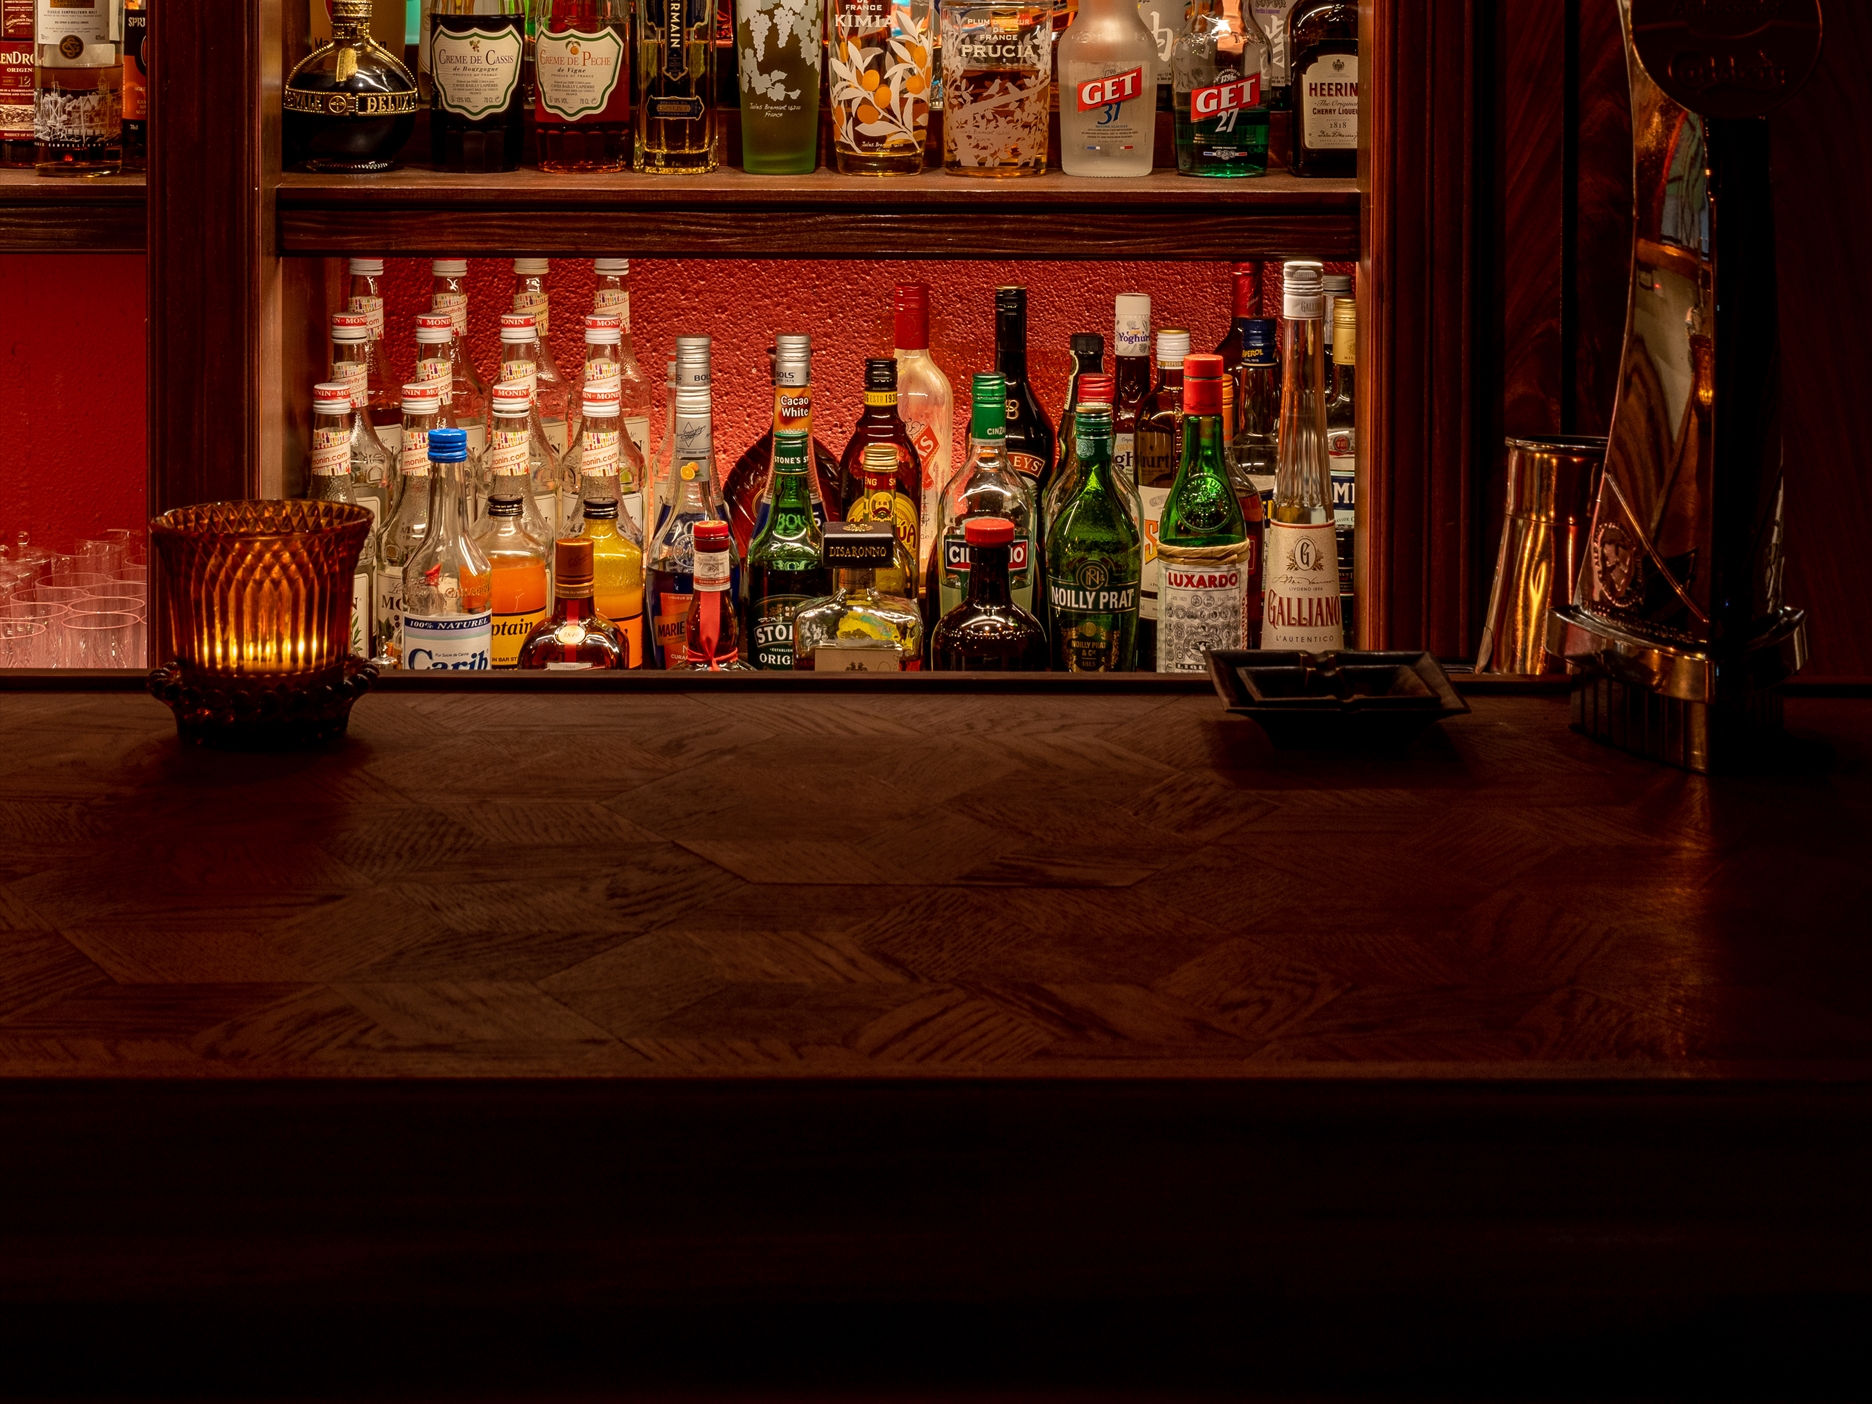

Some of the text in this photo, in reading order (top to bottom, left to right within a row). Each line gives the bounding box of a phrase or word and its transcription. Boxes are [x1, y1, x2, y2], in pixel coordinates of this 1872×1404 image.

[845, 4, 882, 12] FRANCE
[834, 14, 893, 28] KIMIA
[469, 55, 483, 64] DE
[485, 49, 514, 65] CASSIS
[961, 44, 1036, 58] PRUCIA
[567, 57, 579, 66] DE
[462, 65, 499, 73] Bourgogne
[567, 67, 586, 75] Vigne
[18, 75, 31, 87] 12
[1081, 72, 1137, 105] GET
[1309, 82, 1358, 97] HEERIN
[1196, 78, 1257, 113] GET
[1097, 101, 1121, 125] 31
[1312, 107, 1358, 115] CHERRY LIQUEU
[1215, 108, 1239, 133] 27
[1329, 121, 1347, 129] 1818
[1119, 329, 1150, 344] Yoghur
[499, 389, 527, 397] MONIN
[780, 395, 809, 406] Cacao
[781, 407, 809, 418] White
[828, 547, 887, 558] DISARONNO
[1168, 572, 1238, 589] LUXARDO
[1051, 586, 1135, 609] NOILLY PRAT
[1268, 589, 1340, 629] GALLIANO
[410, 617, 488, 629] 100% NATUREL
[491, 619, 533, 640] ptain
[657, 620, 685, 637] MARIE
[1071, 640, 1091, 649] NOILLY
[1276, 635, 1334, 643] L'AUTENTICO
